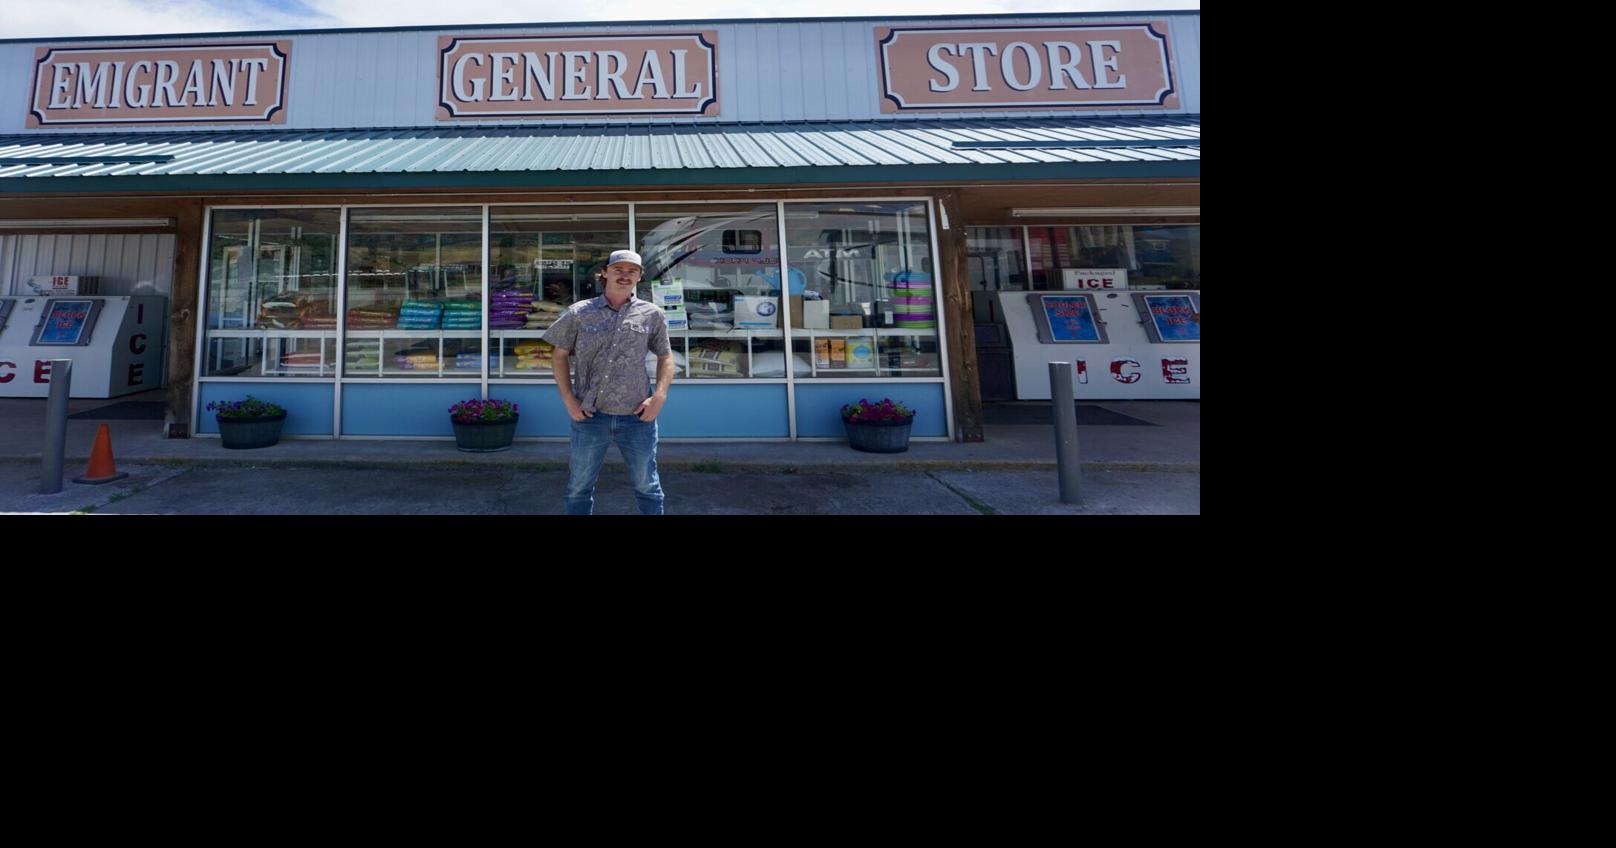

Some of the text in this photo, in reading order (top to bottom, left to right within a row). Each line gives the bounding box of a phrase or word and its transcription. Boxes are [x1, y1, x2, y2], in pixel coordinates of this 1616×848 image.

[49, 58, 268, 109] EMIGRANT
[452, 49, 702, 102] GENERAL
[928, 40, 1127, 92] STORE
[53, 276, 69, 286] ICE
[1078, 278, 1113, 288] ICE
[128, 303, 147, 387] ICE
[1077, 358, 1191, 384] ICE
